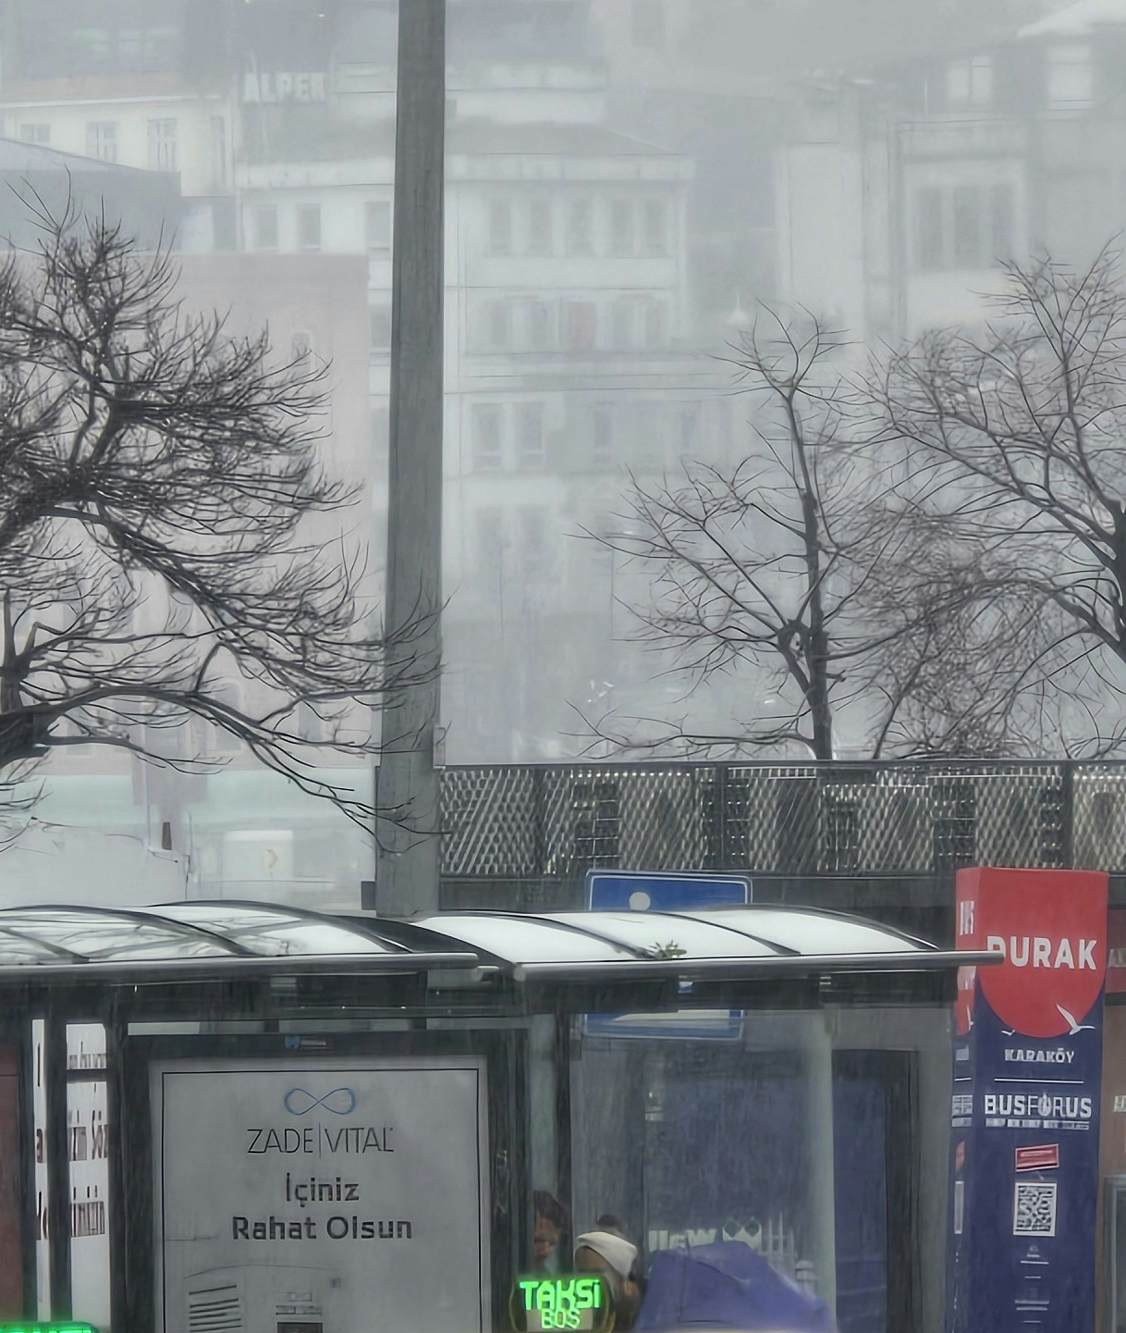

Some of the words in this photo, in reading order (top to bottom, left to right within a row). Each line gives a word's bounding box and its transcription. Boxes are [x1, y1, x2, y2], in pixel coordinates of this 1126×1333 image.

[987, 936, 1097, 970] DURAK
[247, 1128, 314, 1154] ZADE
[324, 1127, 394, 1154] VITAL
[286, 1172, 359, 1208] İçiniz
[232, 1216, 317, 1241] Rahat
[326, 1216, 412, 1241] Olsun
